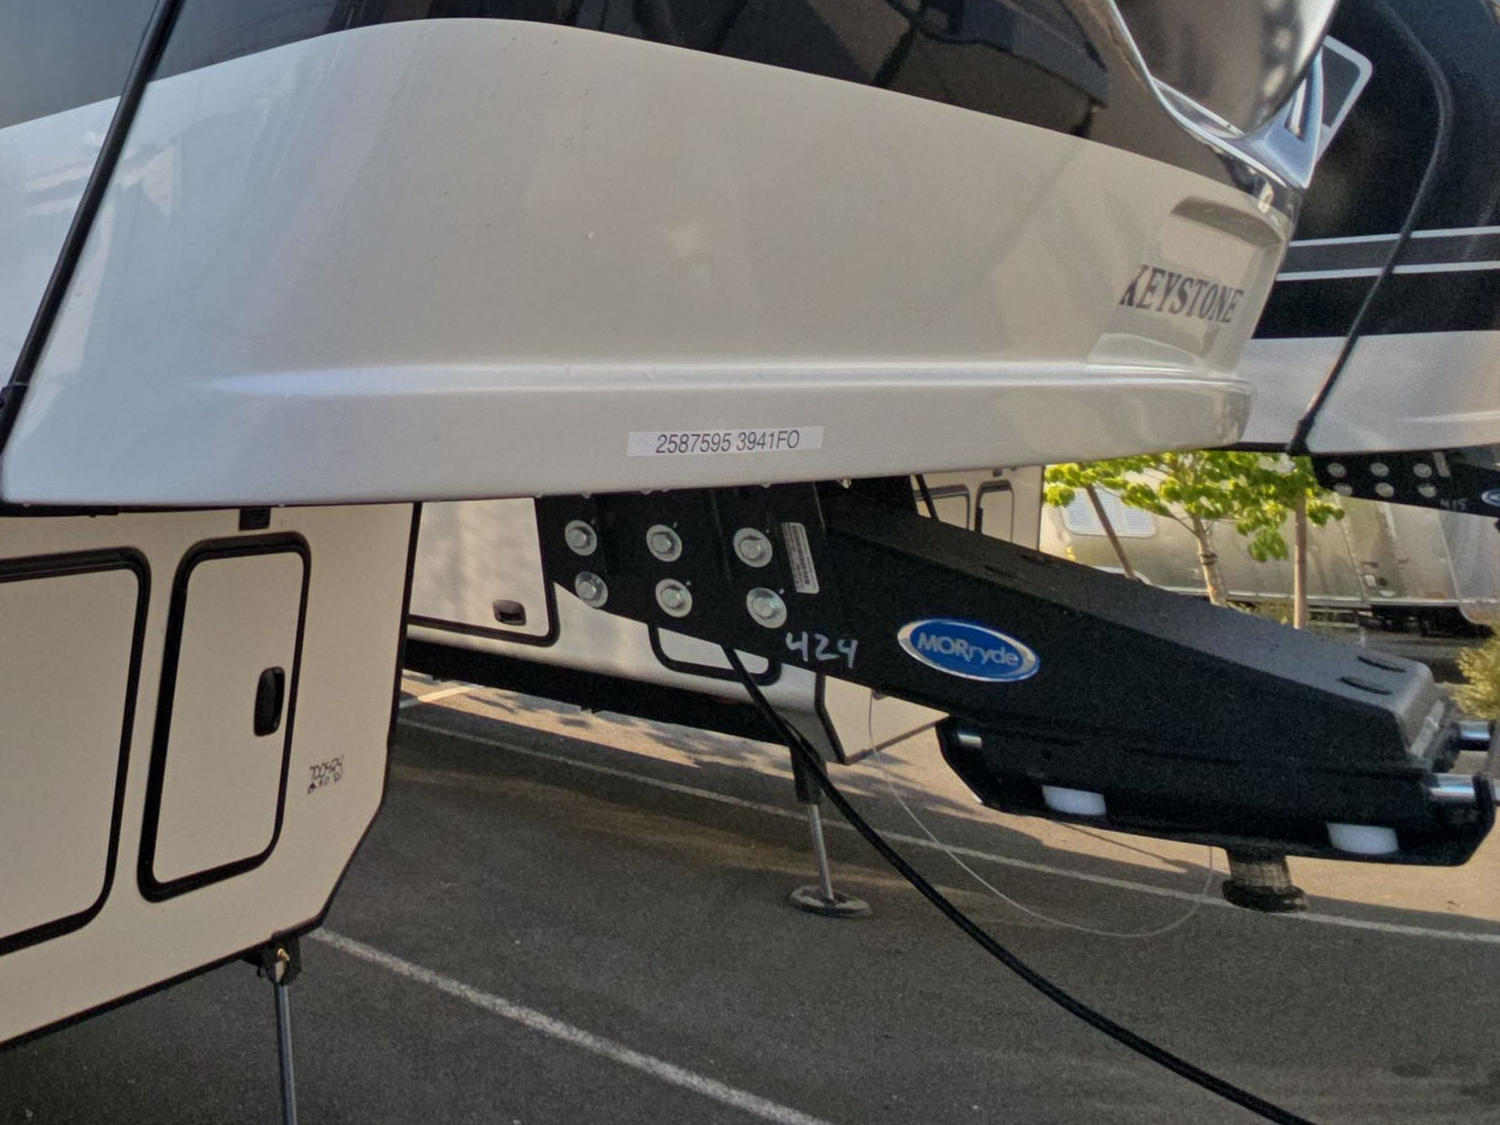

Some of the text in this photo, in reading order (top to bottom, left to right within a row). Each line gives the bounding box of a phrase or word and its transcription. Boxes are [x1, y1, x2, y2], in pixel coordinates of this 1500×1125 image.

[1119, 264, 1244, 323] KEYSTONE
[656, 430, 800, 454] 2587595 3941FO
[785, 631, 858, 668] 424
[917, 632, 1019, 666] MORryde
